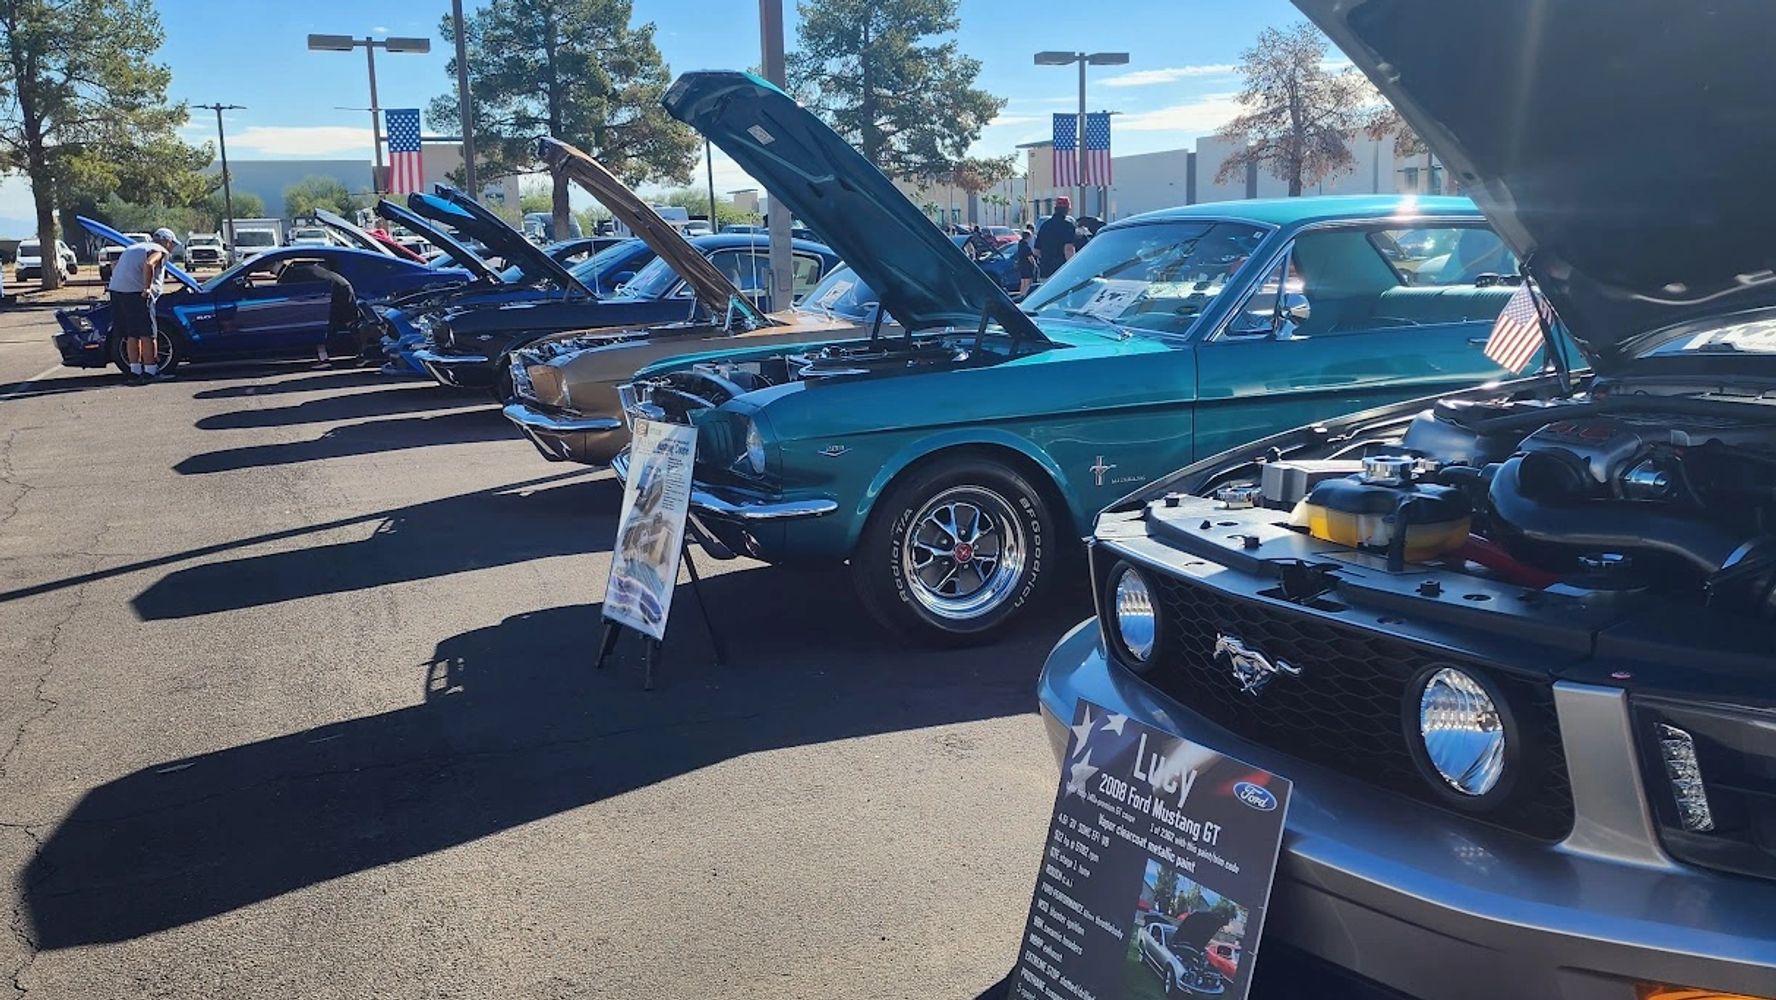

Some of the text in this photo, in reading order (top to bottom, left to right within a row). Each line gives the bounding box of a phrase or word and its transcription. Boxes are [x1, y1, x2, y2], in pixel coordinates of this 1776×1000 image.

[891, 508, 914, 603] Radial T/A
[1014, 497, 1041, 608] BFGoodrich
[1133, 732, 1198, 809] Lucy
[1240, 783, 1270, 808] Ford
[1099, 773, 1128, 802] 2008
[1128, 786, 1152, 814] Ford
[1152, 797, 1200, 842] Mustang
[1202, 821, 1221, 846] GT
[1099, 813, 1196, 873] Vapor clearcoat metallic paint
